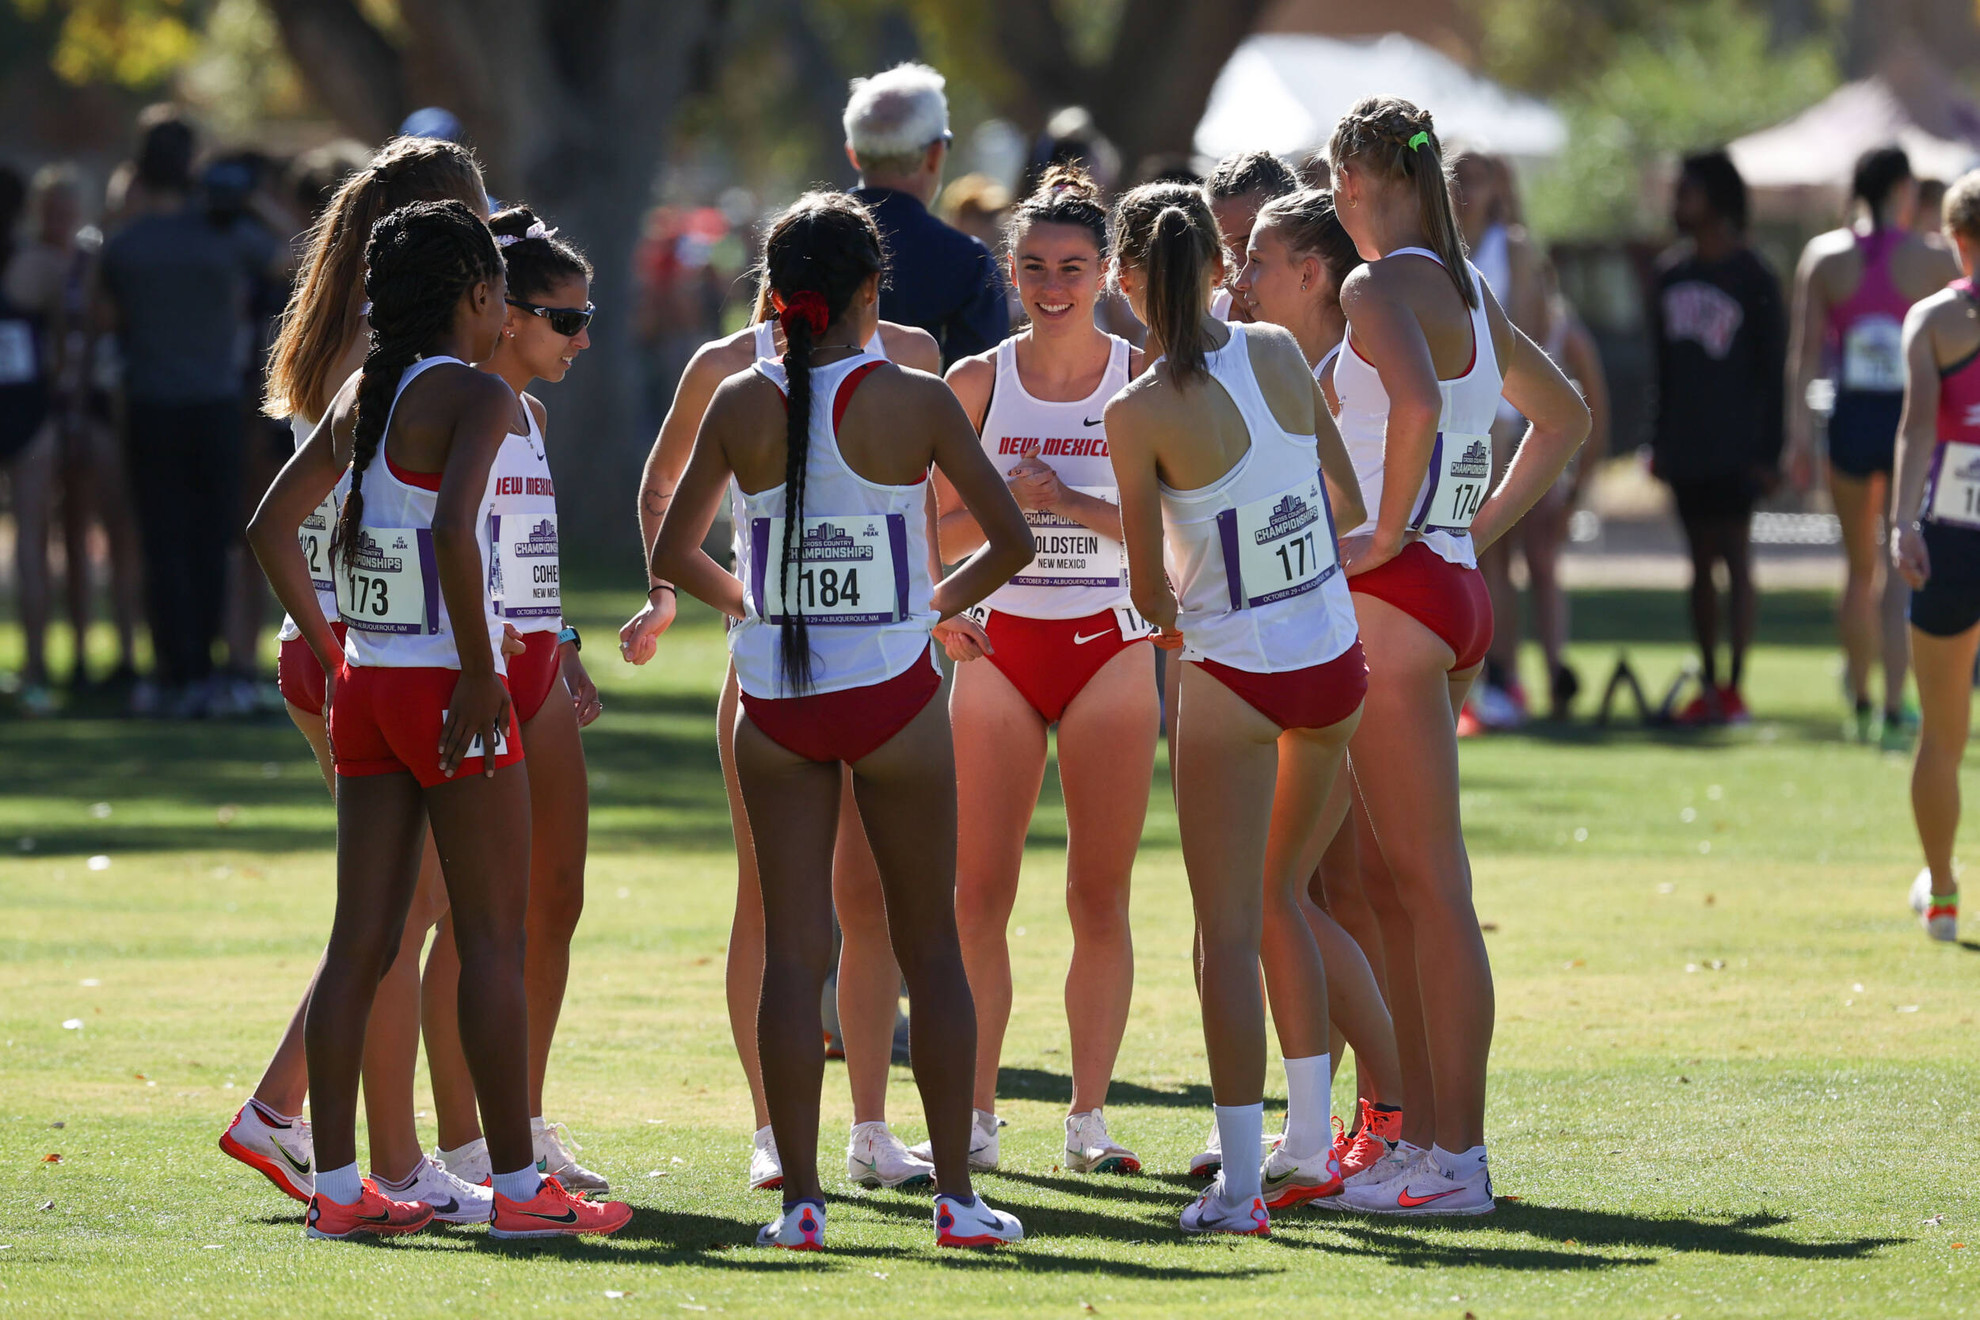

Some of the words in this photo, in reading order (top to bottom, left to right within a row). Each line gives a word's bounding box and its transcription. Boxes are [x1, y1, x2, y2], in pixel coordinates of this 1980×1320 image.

[1452, 484, 1481, 520] 174
[1255, 508, 1318, 541] CHAMPIONSHIPS
[1035, 536, 1098, 555] OLDSTEIN
[1276, 531, 1316, 581] 177
[533, 565, 558, 583] COHE
[1038, 558, 1055, 569] NEW
[1057, 558, 1086, 570] MEXICO
[350, 574, 388, 616] 173
[533, 588, 546, 598] NEW
[801, 568, 860, 608] 184
[1263, 590, 1290, 603] OCTOBER
